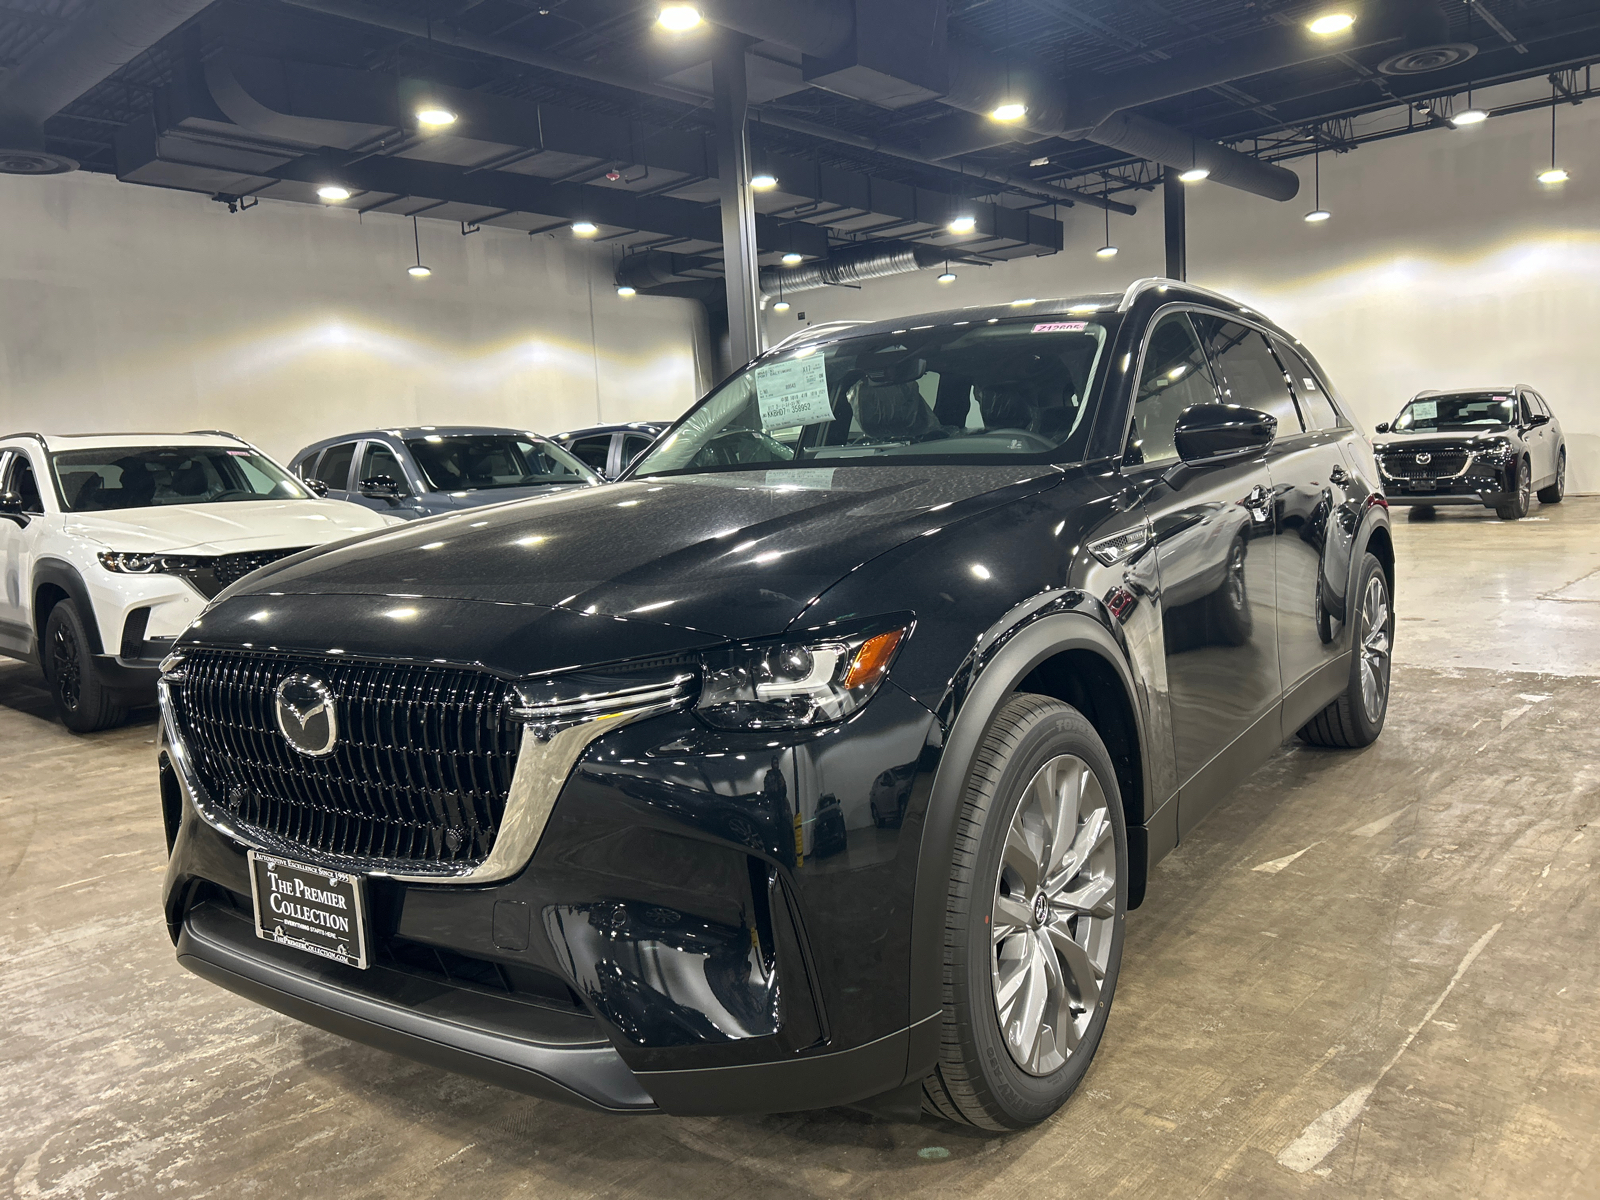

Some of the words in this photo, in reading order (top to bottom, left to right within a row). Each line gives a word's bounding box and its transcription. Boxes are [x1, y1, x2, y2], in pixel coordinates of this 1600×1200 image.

[267, 871, 294, 895] THE
[294, 878, 347, 909] PREMIER
[270, 893, 349, 932] COLLECTION
